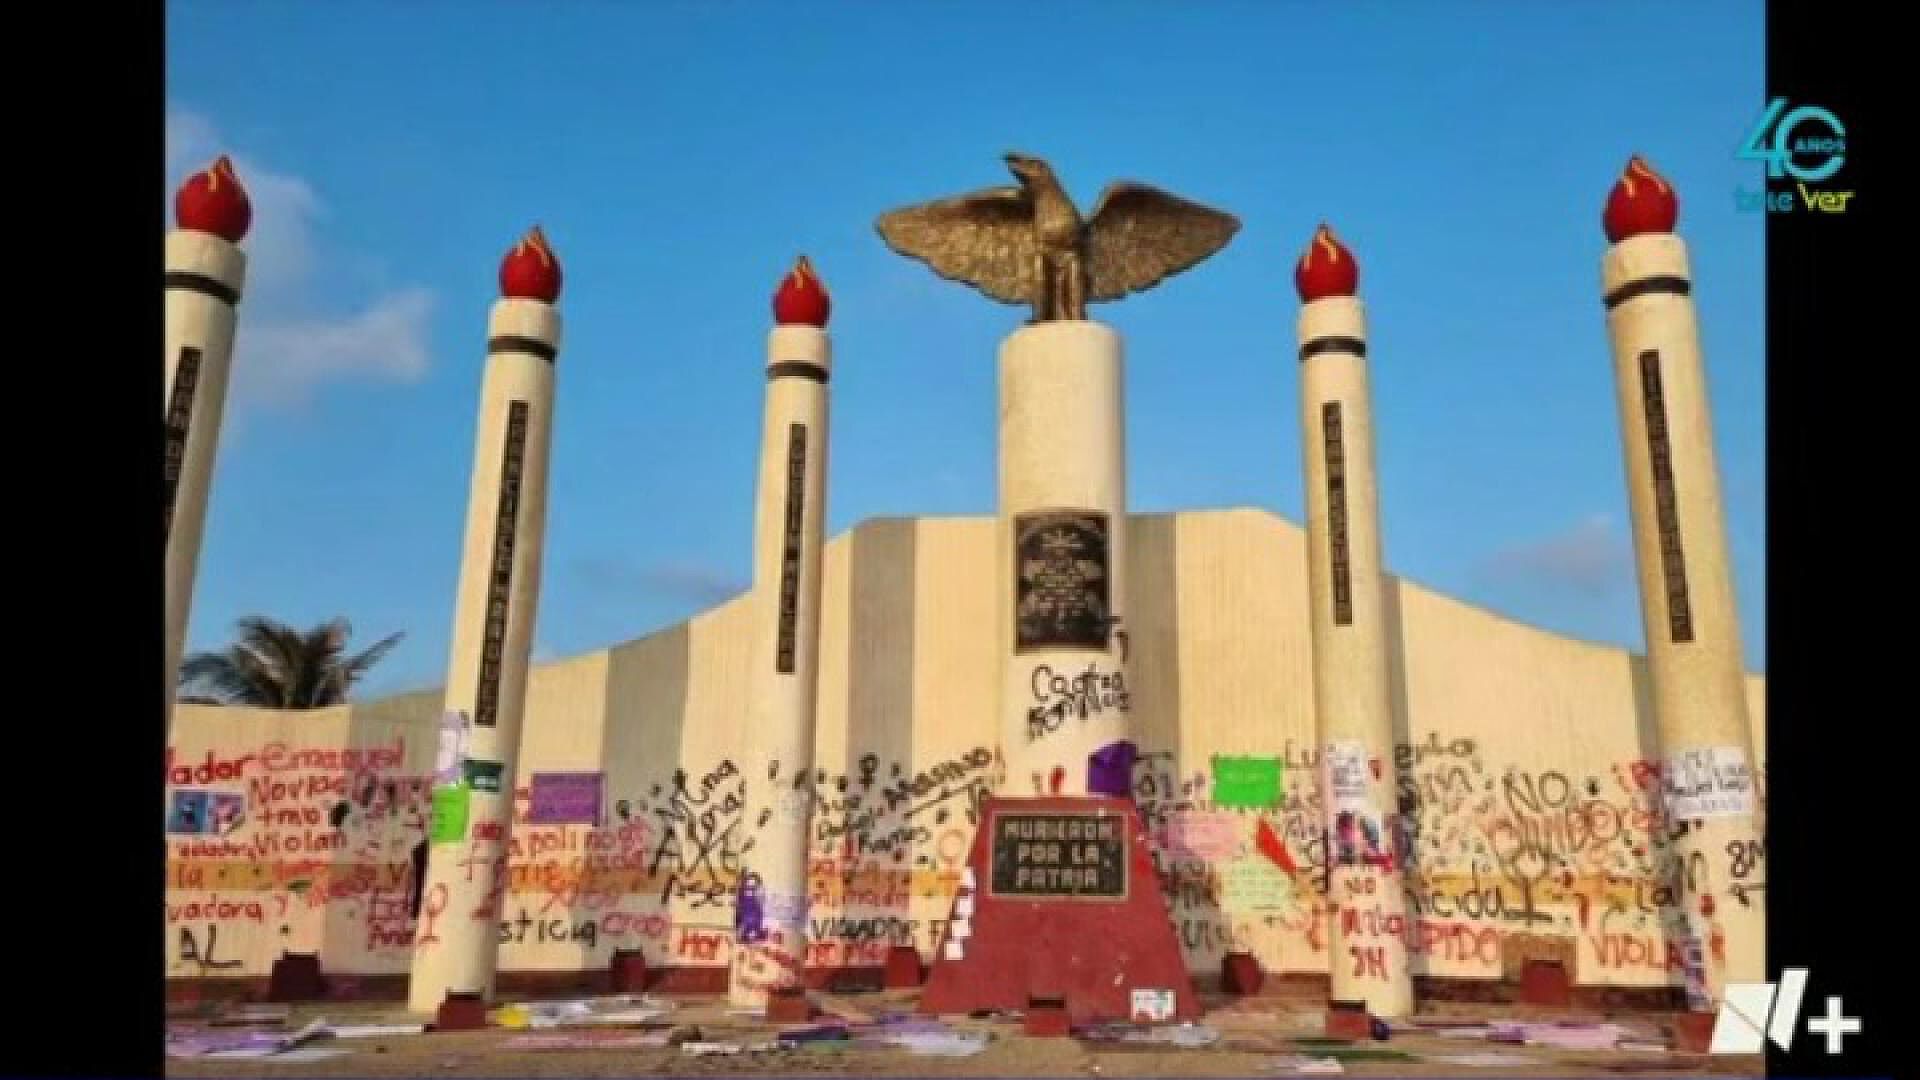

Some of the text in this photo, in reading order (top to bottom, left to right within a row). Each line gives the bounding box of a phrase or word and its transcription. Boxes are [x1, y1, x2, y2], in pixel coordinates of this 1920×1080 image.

[1017, 843, 1099, 864] POR LA
[1016, 868, 1099, 889] PATRIA
